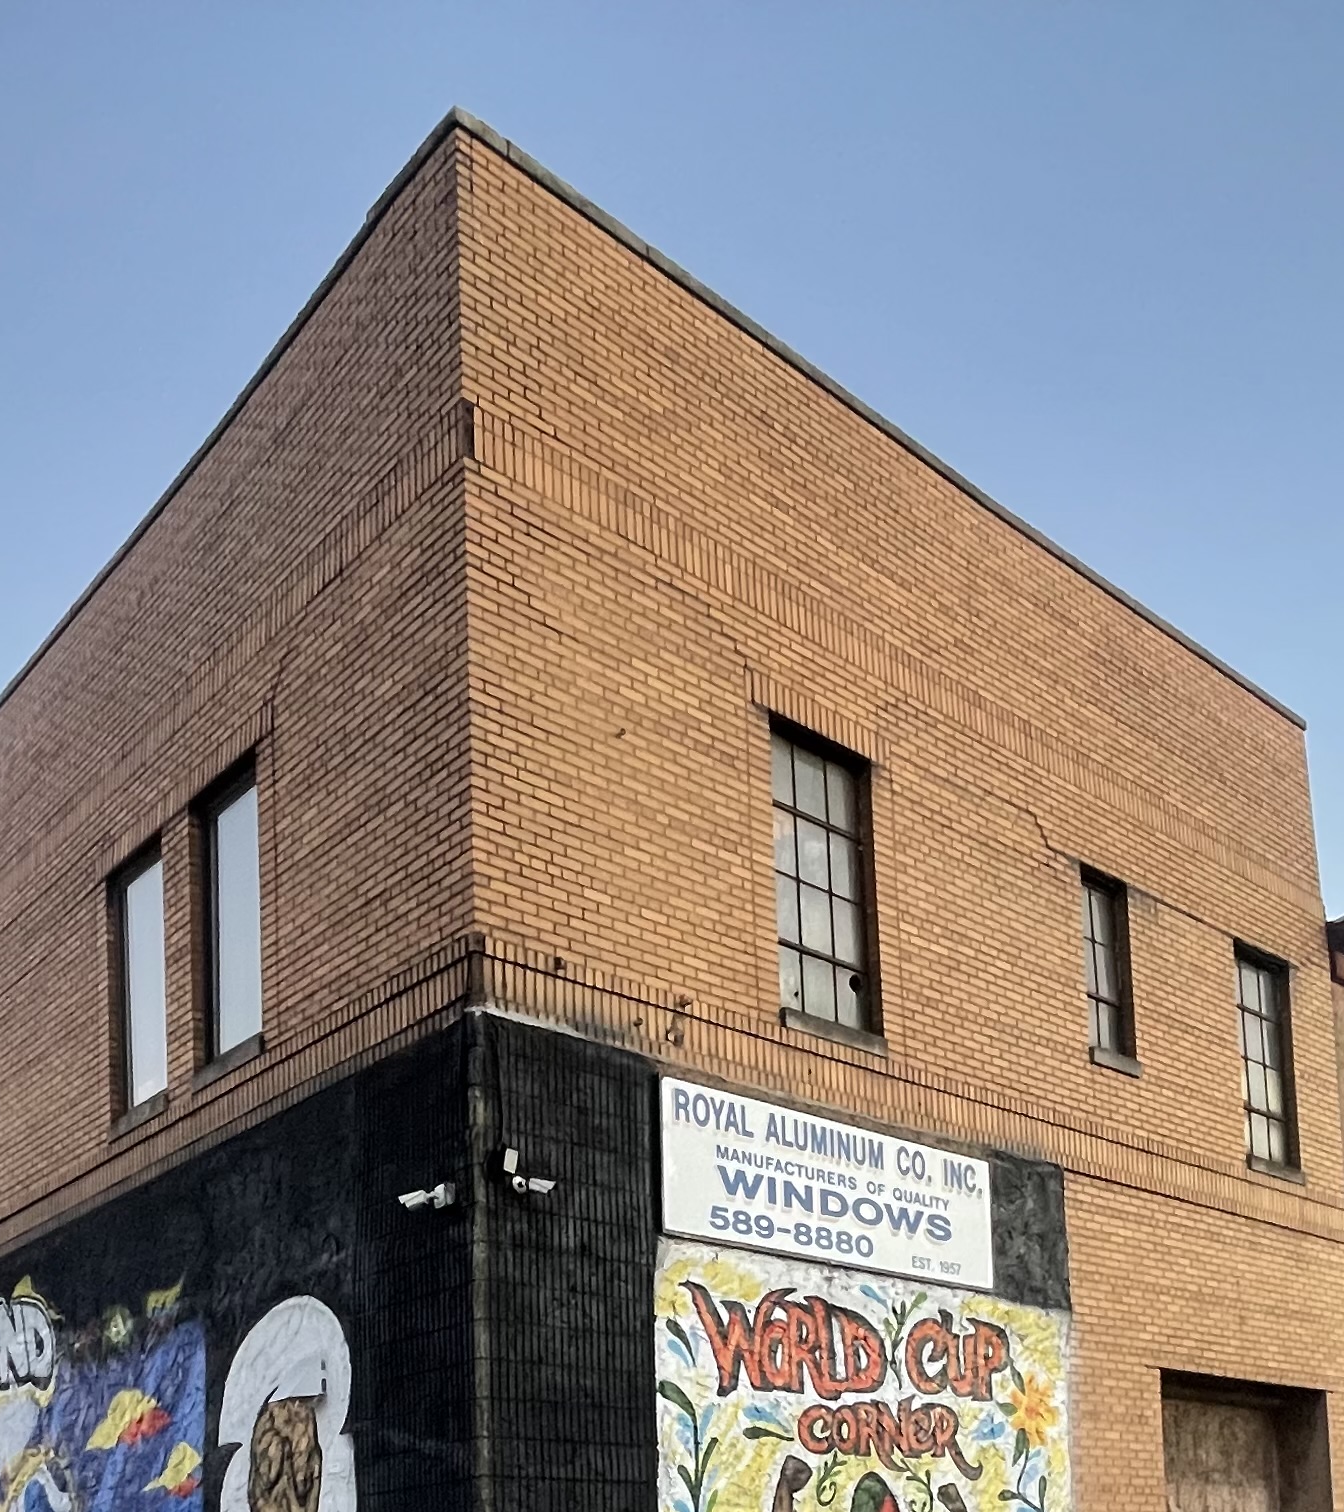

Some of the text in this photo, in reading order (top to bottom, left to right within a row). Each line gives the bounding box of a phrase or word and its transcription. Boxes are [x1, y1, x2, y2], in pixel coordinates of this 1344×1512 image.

[674, 1088, 983, 1195] ROYAL ALUMINUM CO. INC.
[716, 1145, 949, 1211] MANUFACTURERS OF QUALITY
[709, 1205, 873, 1258] 589-8880
[716, 1165, 952, 1241] WINDOWS
[911, 1255, 961, 1275] EST. 1957
[905, 1309, 1012, 1401] CUP
[797, 1398, 983, 1481] CORNER
